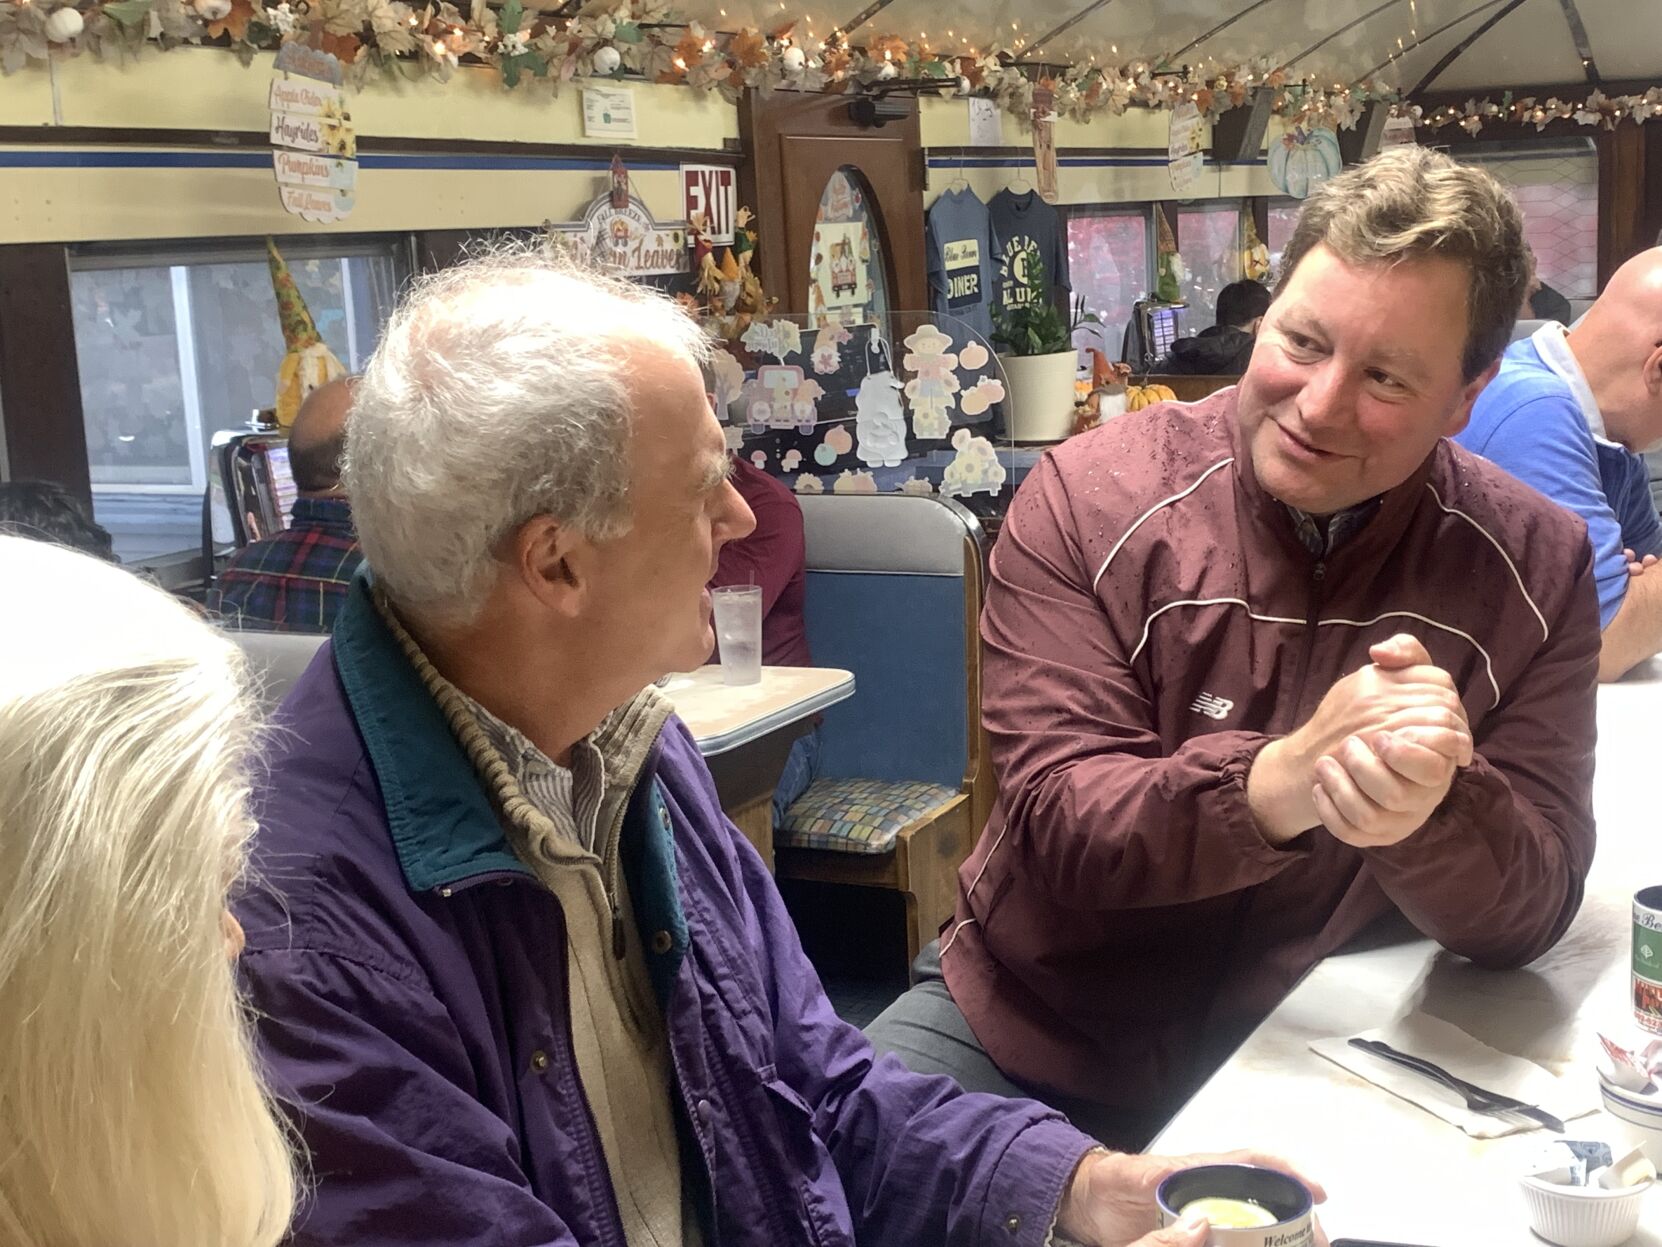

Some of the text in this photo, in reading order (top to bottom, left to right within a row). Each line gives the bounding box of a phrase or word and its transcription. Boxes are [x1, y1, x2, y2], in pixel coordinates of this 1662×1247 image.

[275, 115, 319, 144] Hayrides
[278, 152, 329, 183] Pumpkins
[685, 170, 732, 234] EXIT
[1000, 235, 1021, 278] BLUE
[946, 273, 979, 299] DINER
[1264, 1227, 1306, 1247] Welcome
